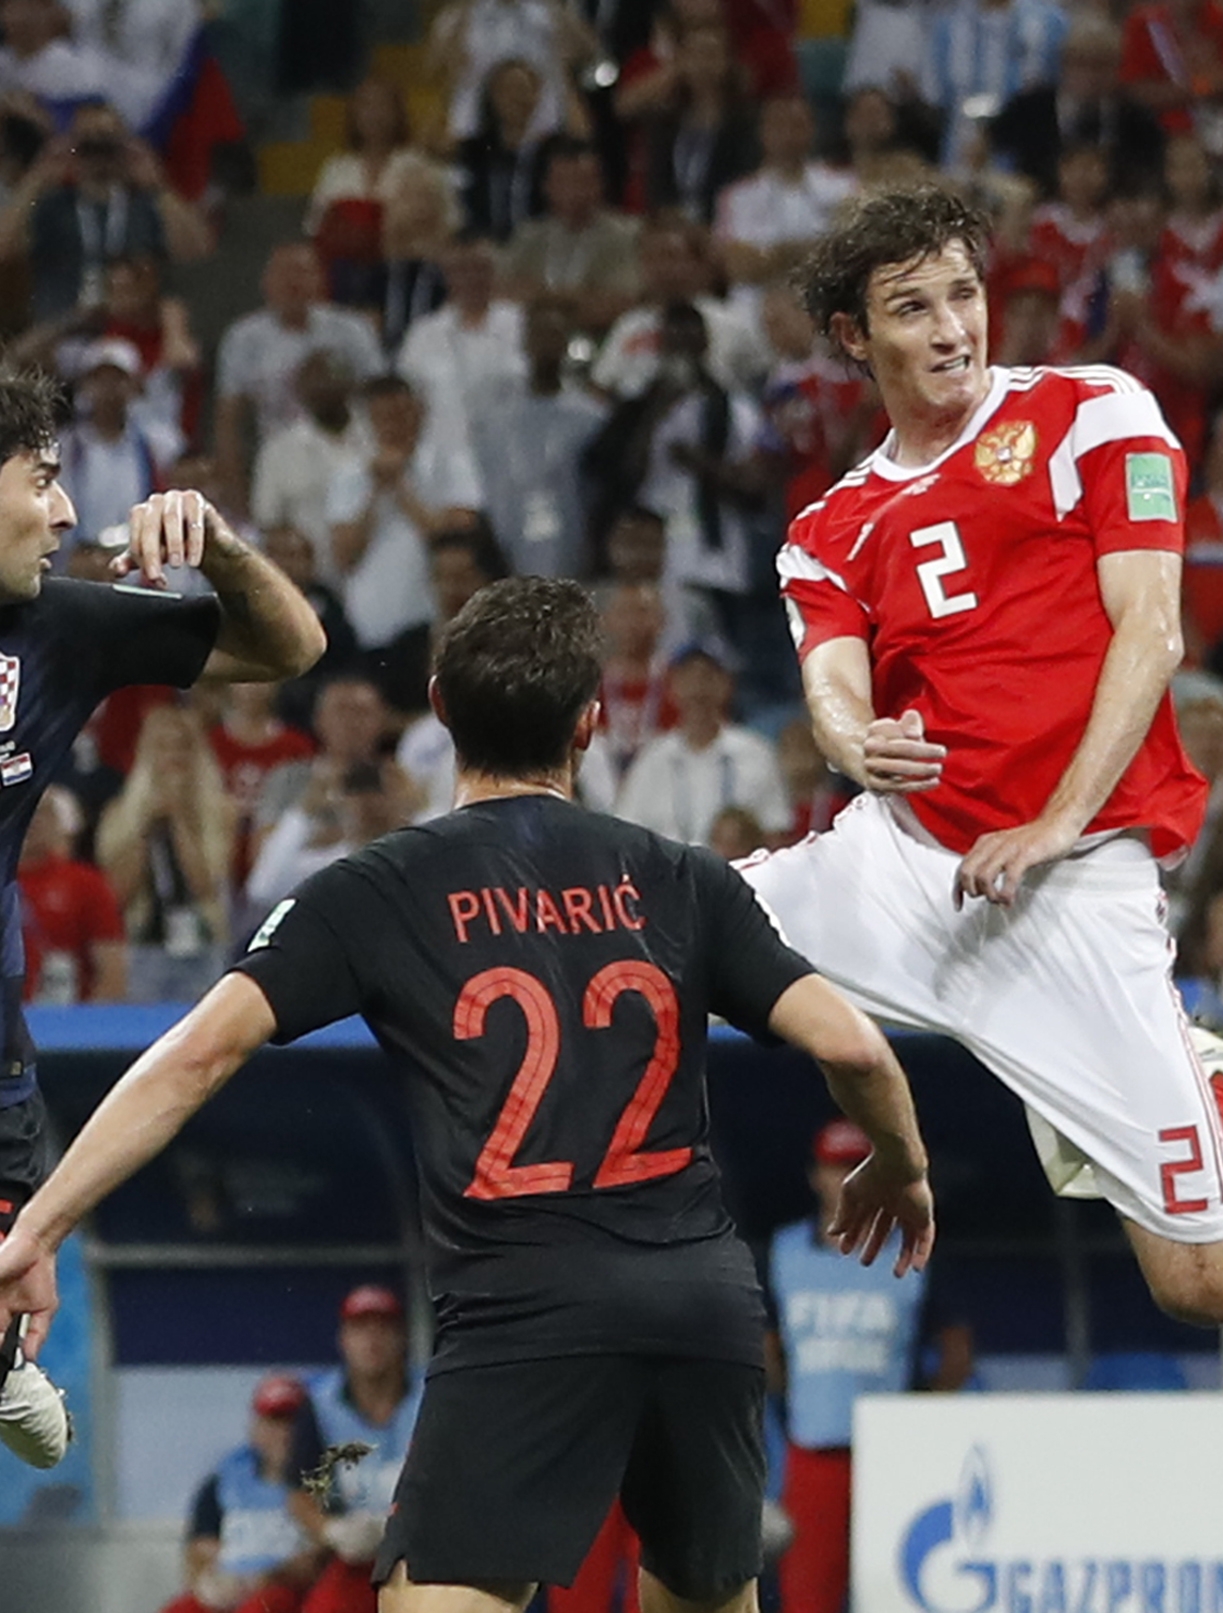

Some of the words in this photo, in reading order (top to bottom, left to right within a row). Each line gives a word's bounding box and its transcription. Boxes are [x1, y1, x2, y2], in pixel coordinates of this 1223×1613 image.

[909, 520, 979, 619] 2
[448, 873, 645, 943] PIVARIĆ
[453, 959, 693, 1200] 22
[1158, 1124, 1209, 1214] 2
